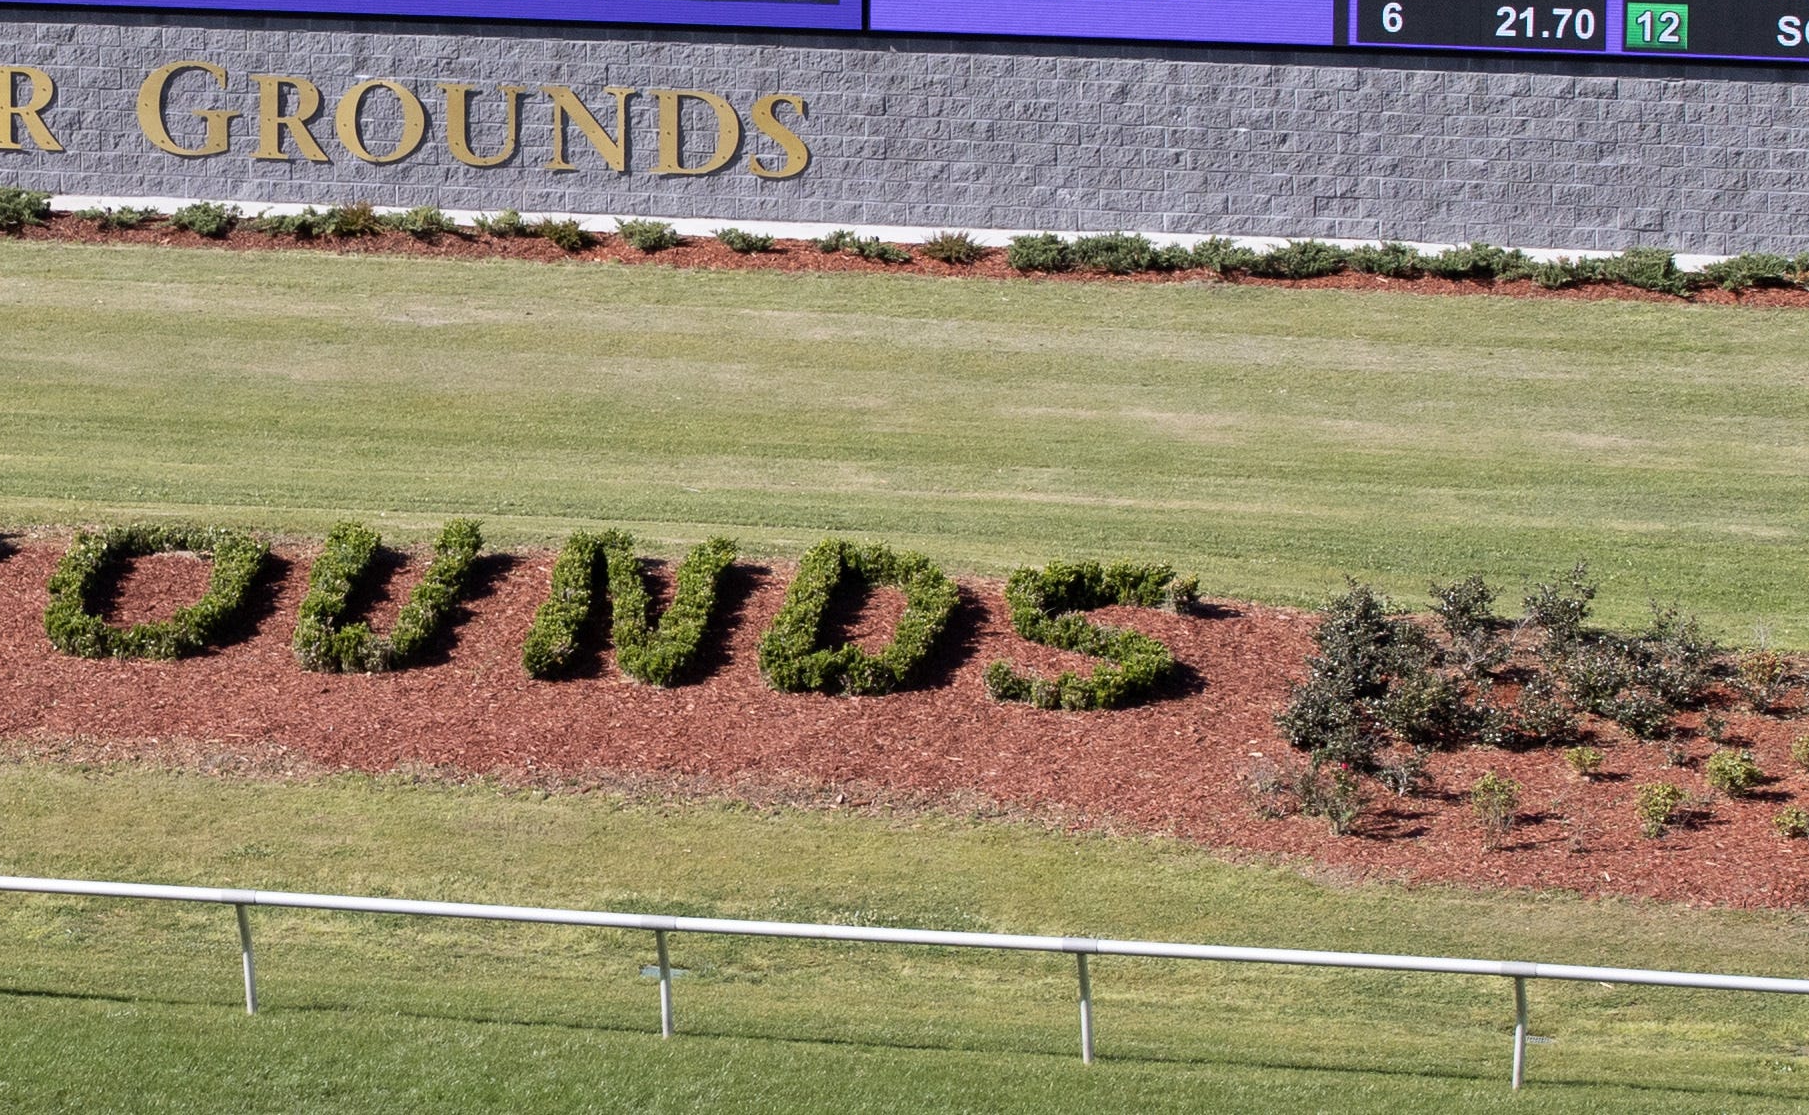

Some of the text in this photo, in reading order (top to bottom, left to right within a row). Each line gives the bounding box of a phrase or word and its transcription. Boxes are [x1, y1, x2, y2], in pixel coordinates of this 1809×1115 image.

[1382, 2, 1680, 43] 6 21.70 12
[136, 61, 810, 181] GROUNDS
